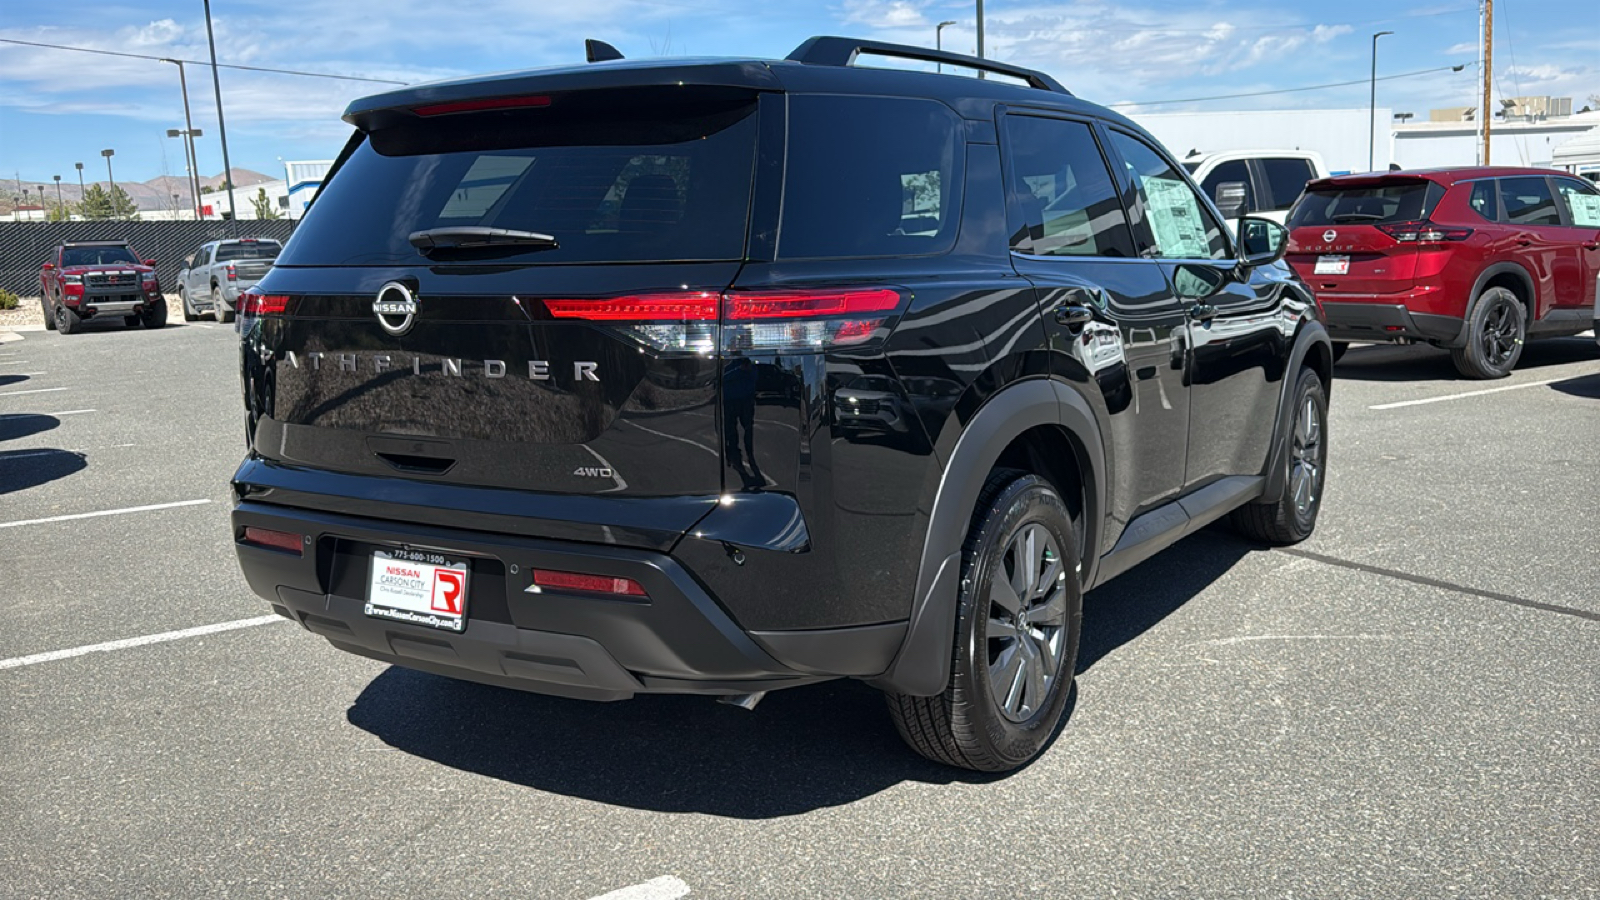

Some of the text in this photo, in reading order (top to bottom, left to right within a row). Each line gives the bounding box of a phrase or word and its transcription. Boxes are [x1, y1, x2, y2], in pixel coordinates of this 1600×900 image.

[373, 301, 417, 314] NISSAN
[260, 349, 600, 382] PATHFINDER
[573, 466, 612, 477] 4WD
[394, 549, 444, 564] 775-600-1500
[386, 566, 420, 578] NISSAN
[380, 574, 426, 590] CARSON CITY
[438, 573, 461, 613] R
